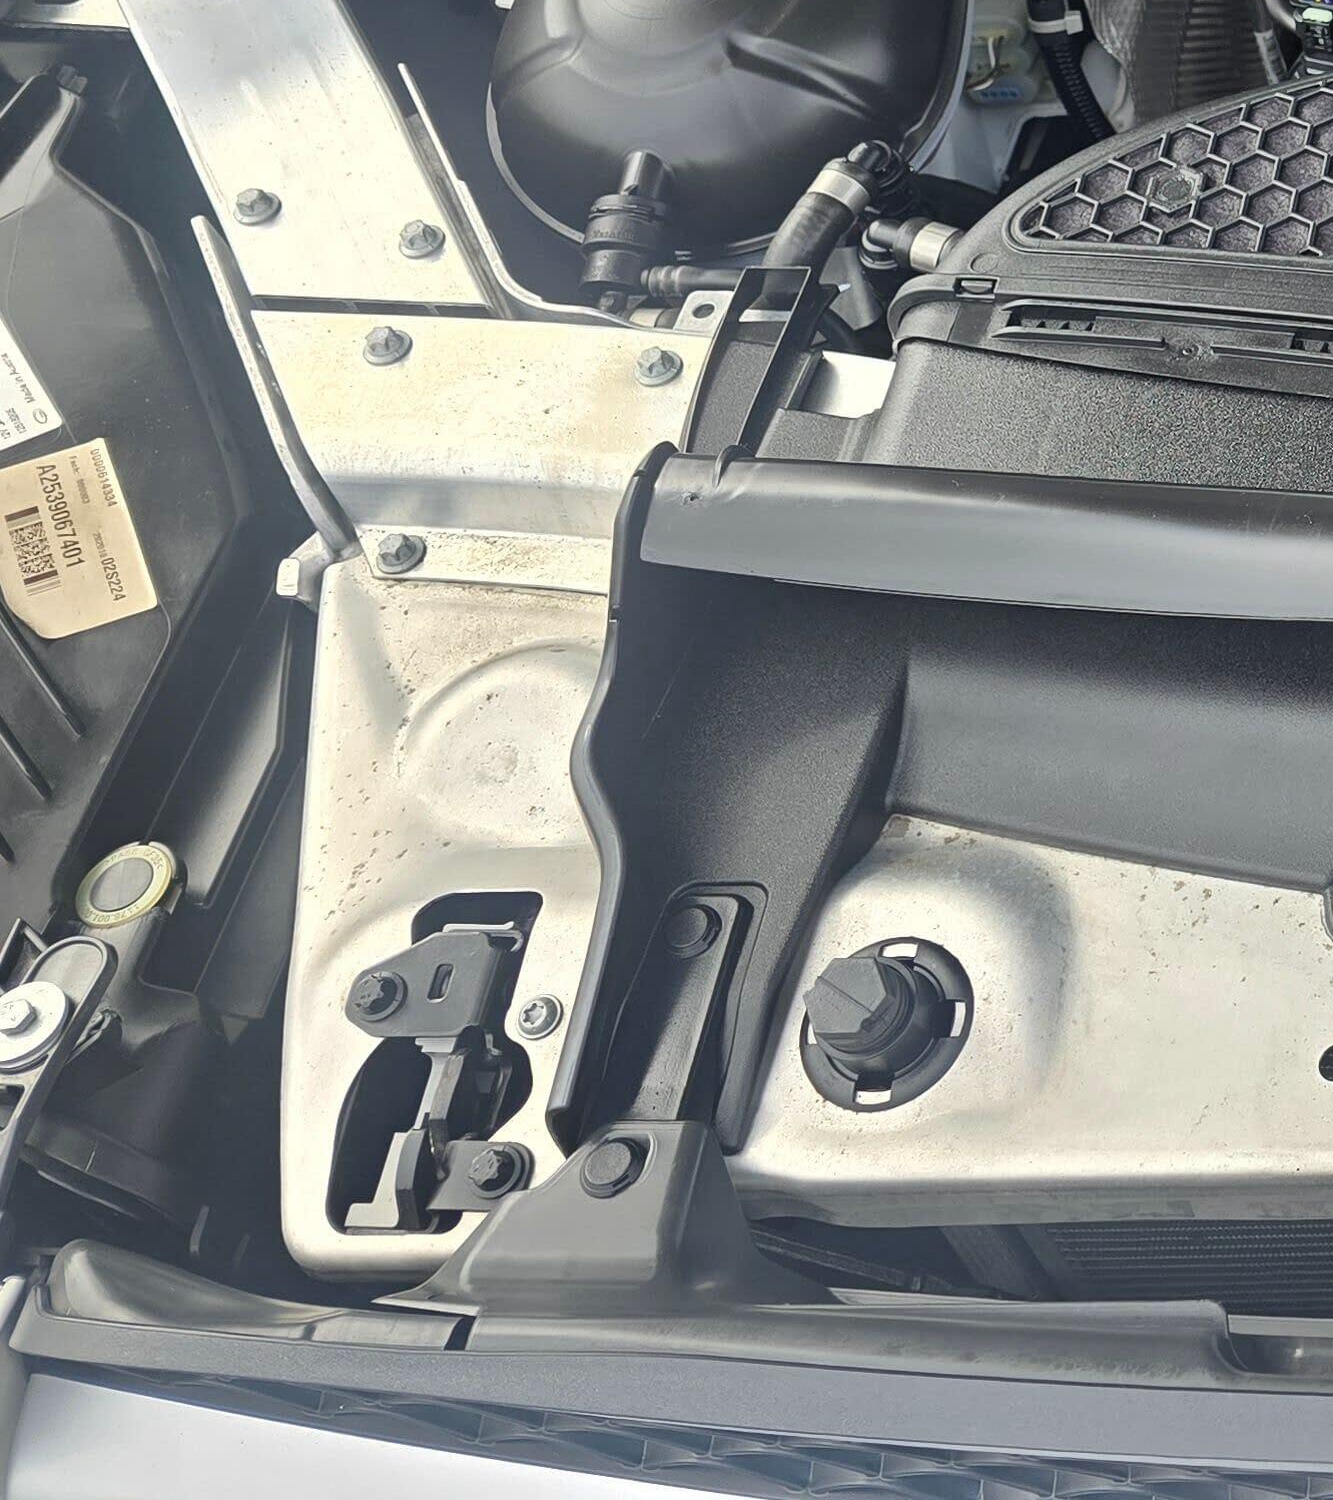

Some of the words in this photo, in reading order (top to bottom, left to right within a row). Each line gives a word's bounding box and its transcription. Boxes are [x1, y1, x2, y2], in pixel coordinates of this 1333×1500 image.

[90, 448, 118, 508] 0000614334
[36, 463, 86, 568] A2539067401
[101, 557, 126, 601] 02S224
